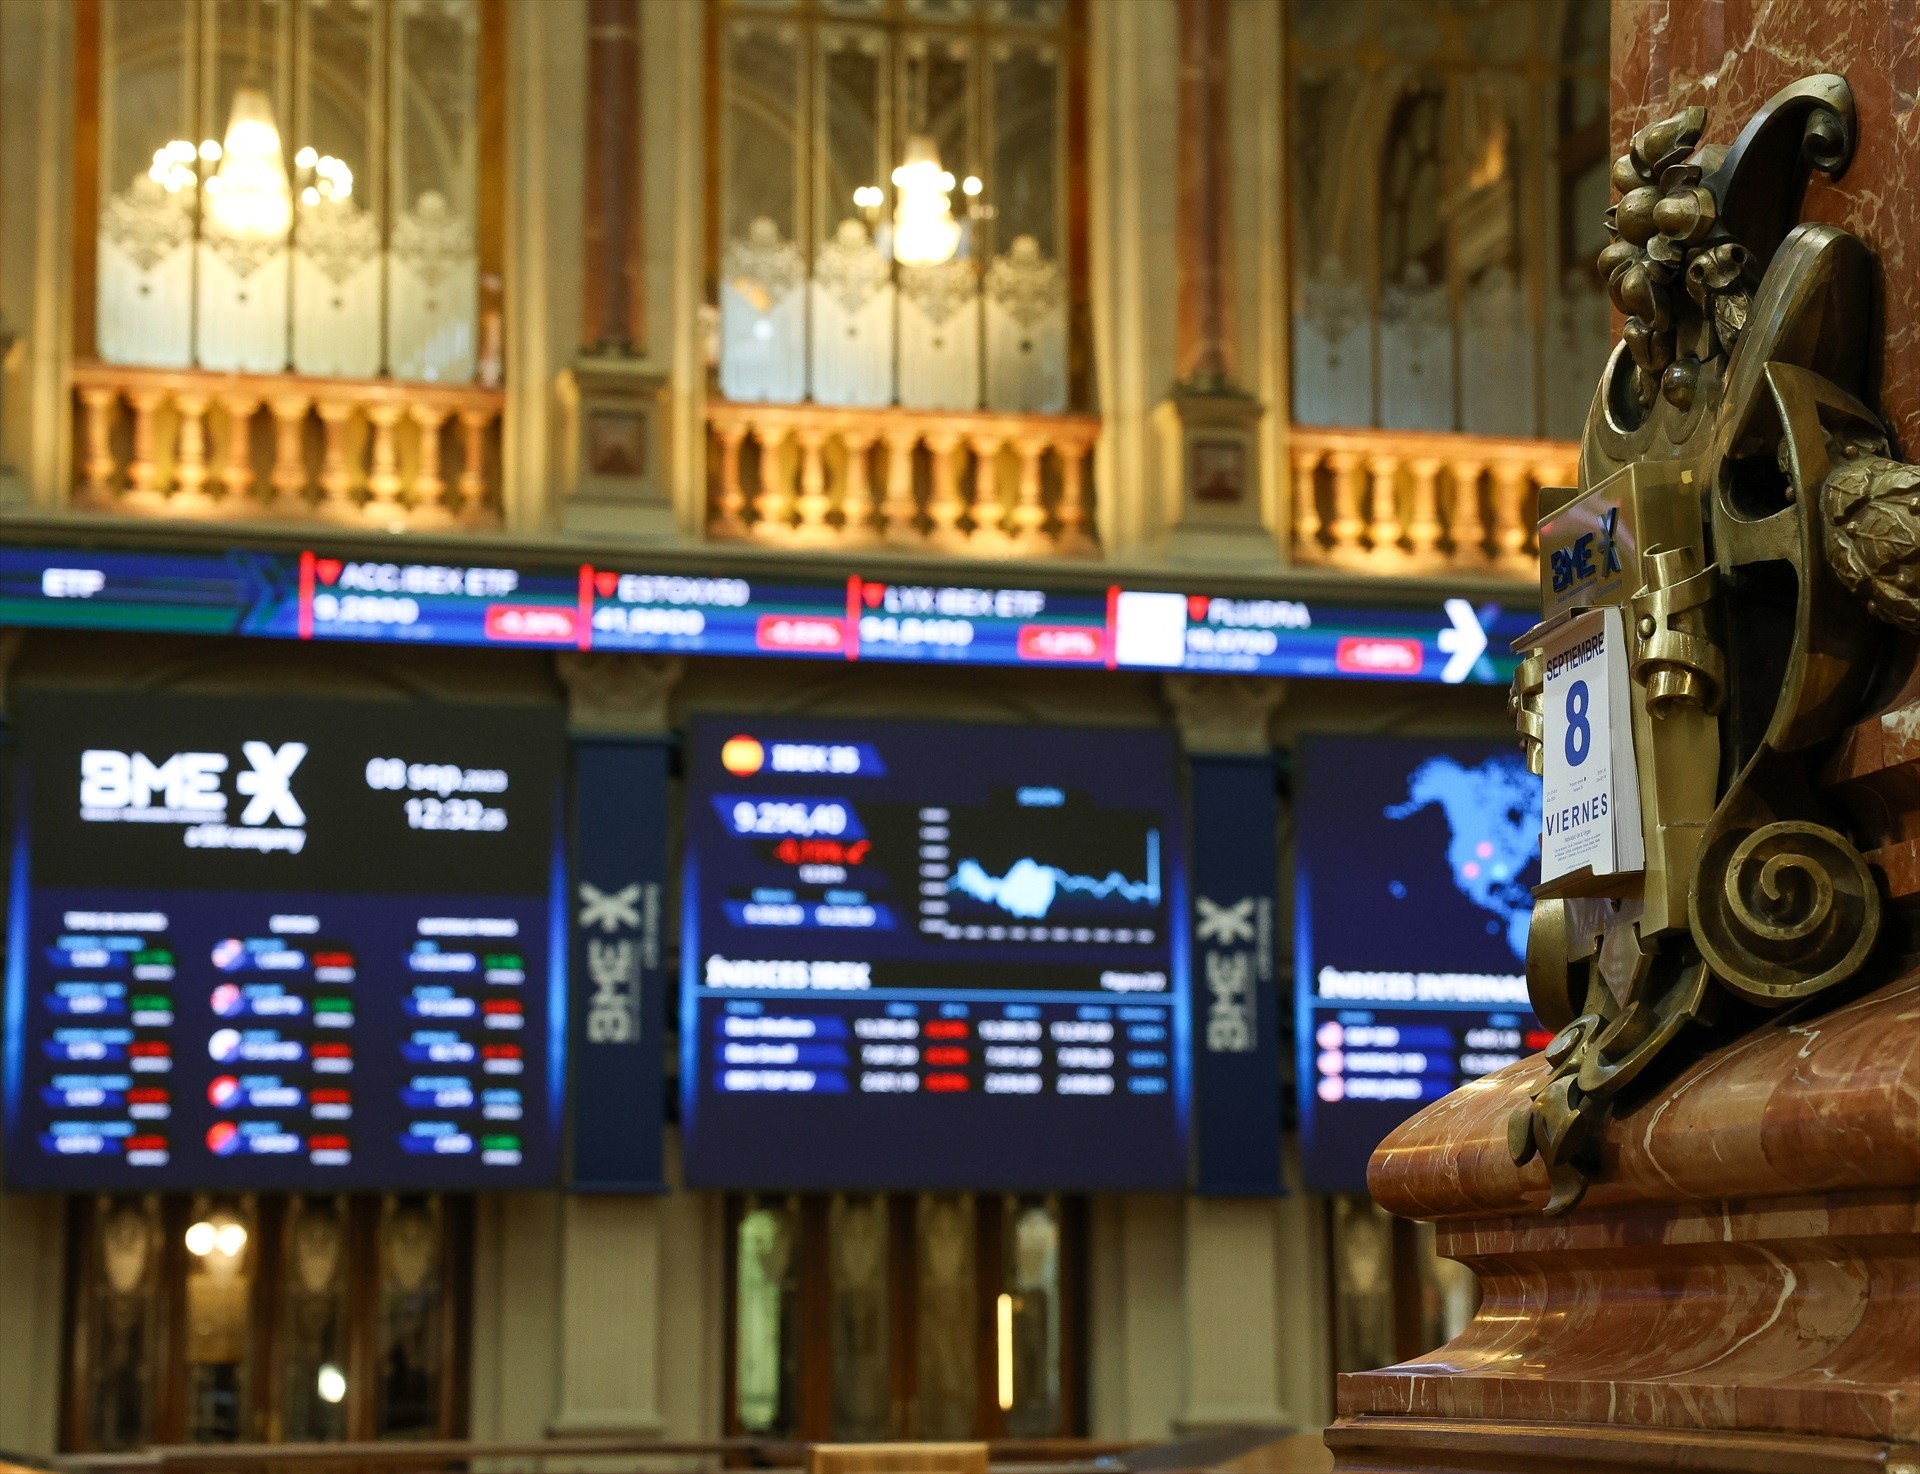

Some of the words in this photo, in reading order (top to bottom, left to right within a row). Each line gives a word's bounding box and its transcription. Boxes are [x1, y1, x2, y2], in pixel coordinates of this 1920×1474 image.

[1551, 532, 1596, 593] BME
[1546, 631, 1605, 682] SEPTIEMBRE
[1564, 680, 1591, 767] 8
[80, 750, 229, 809] BME
[1546, 793, 1608, 836] VIERNES
